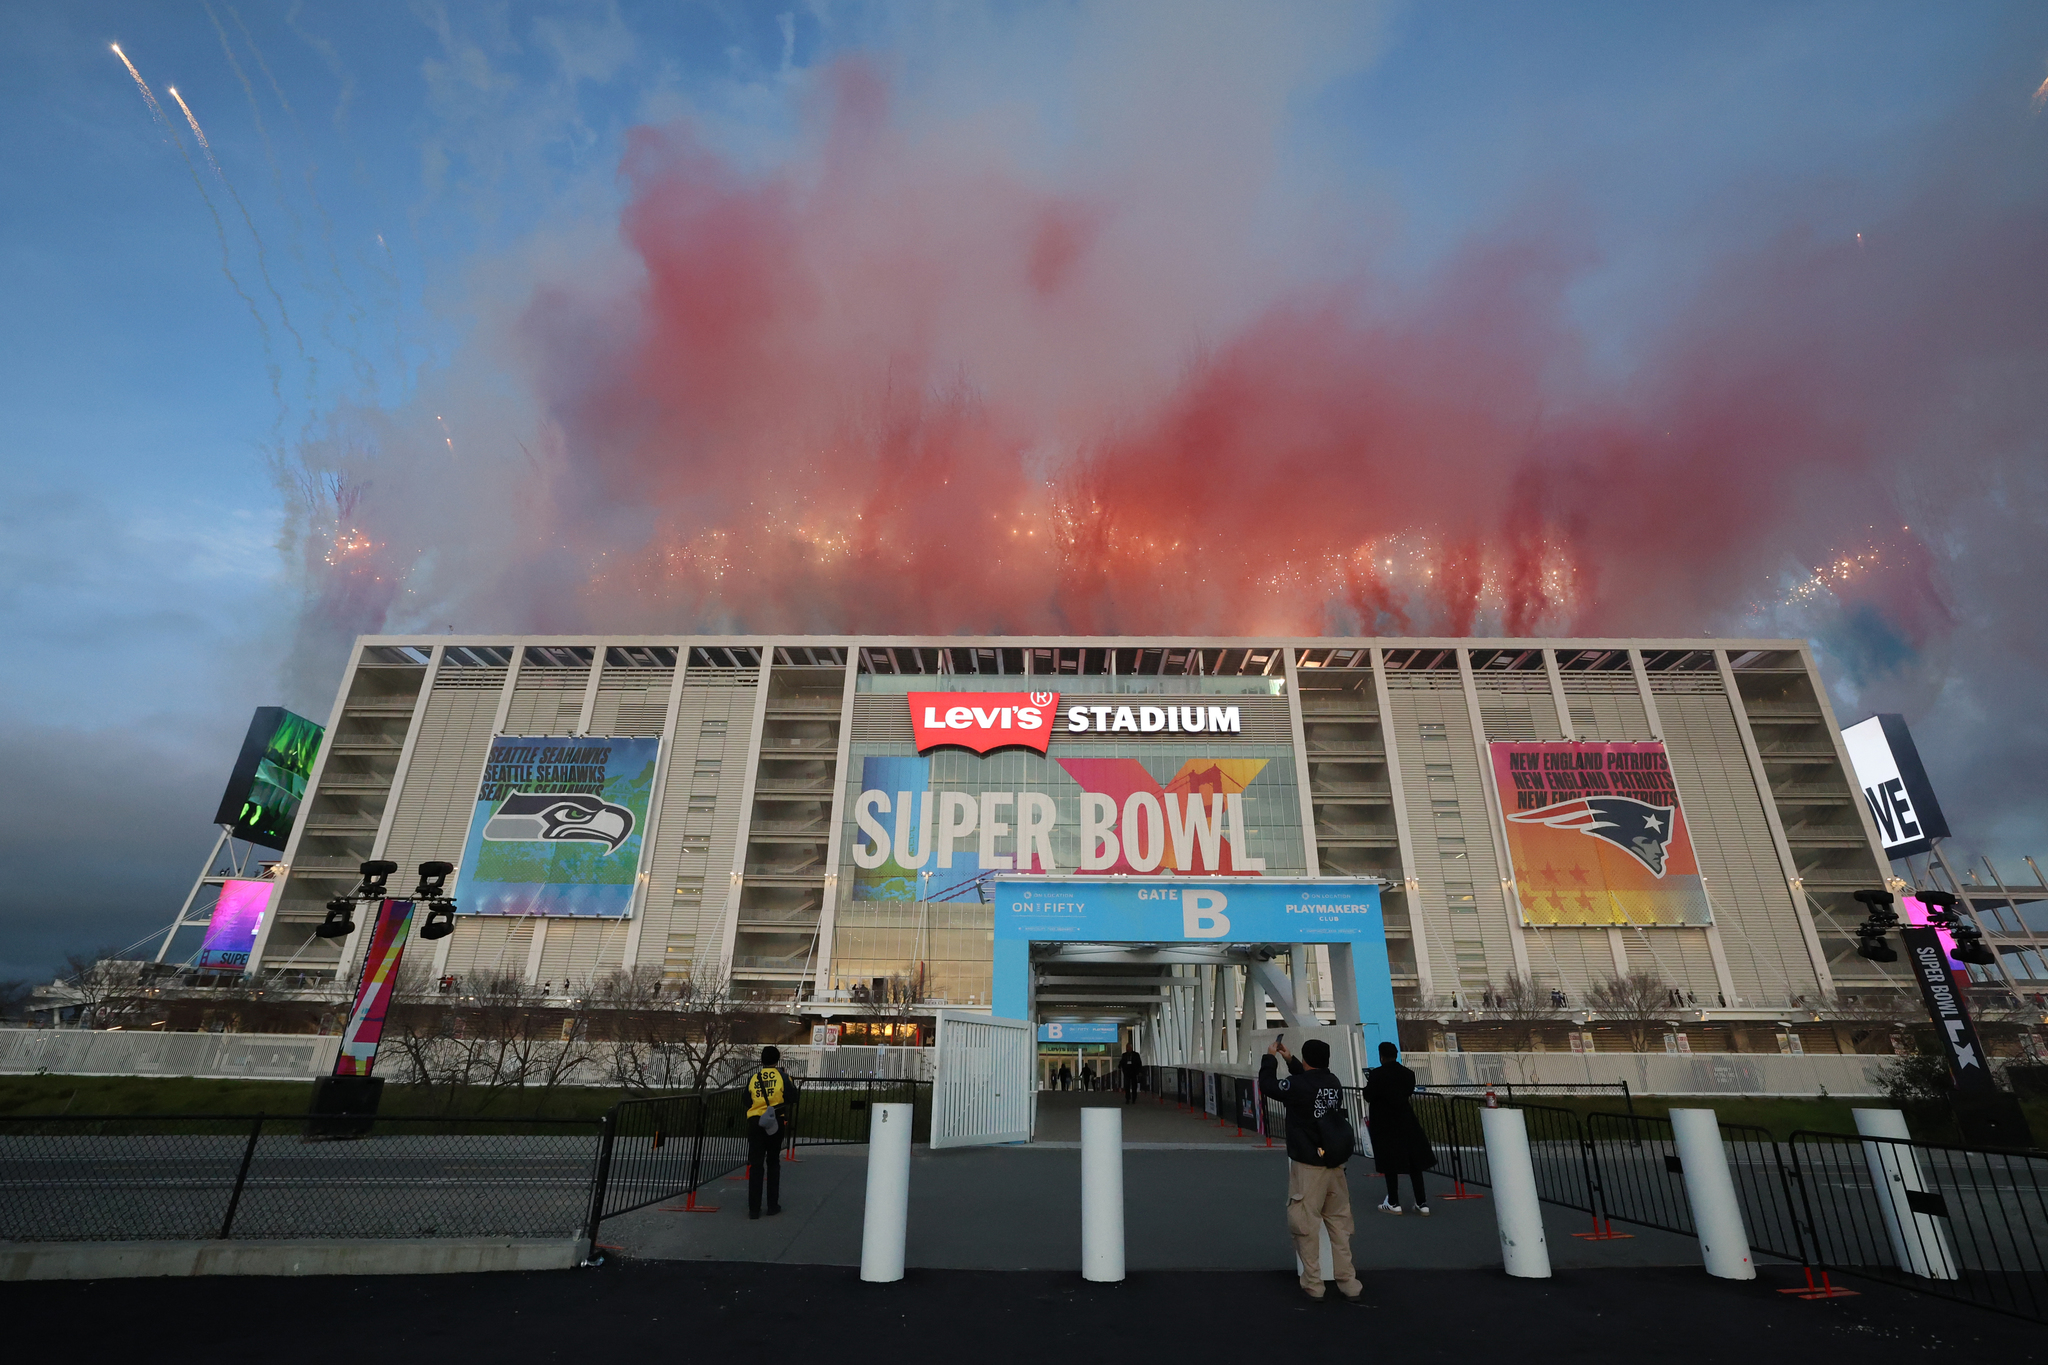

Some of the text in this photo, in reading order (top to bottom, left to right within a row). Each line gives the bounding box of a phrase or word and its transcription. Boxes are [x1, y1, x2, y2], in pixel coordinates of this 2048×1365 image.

[1067, 706, 1241, 733] STADIUM
[489, 746, 612, 765] SEATTLE SEAHAWKS
[1509, 752, 1670, 771] NEW ENGLAND PATRIOTS
[483, 765, 606, 784] SEATTLE SEAHAWKS
[1511, 771, 1675, 790] NEW ENGLAND PATRIOTS
[1517, 790, 1548, 809] NEW
[1616, 790, 1679, 809] RIOTS
[1864, 777, 1921, 843] VE
[852, 788, 1267, 873] SUPER BOWL
[1012, 902, 1034, 912] ON
[1043, 902, 1085, 913] FIFTY
[1137, 888, 1231, 939] GATE B
[1285, 904, 1370, 914] PLAYMAKERS'
[219, 952, 251, 966] SUPE
[1916, 946, 1981, 1070] SUPER BOWL LX
[1048, 1022, 1063, 1039] B
[757, 1071, 776, 1080] SC
[755, 1087, 775, 1098] STFF
[1315, 1088, 1339, 1099] APEX
